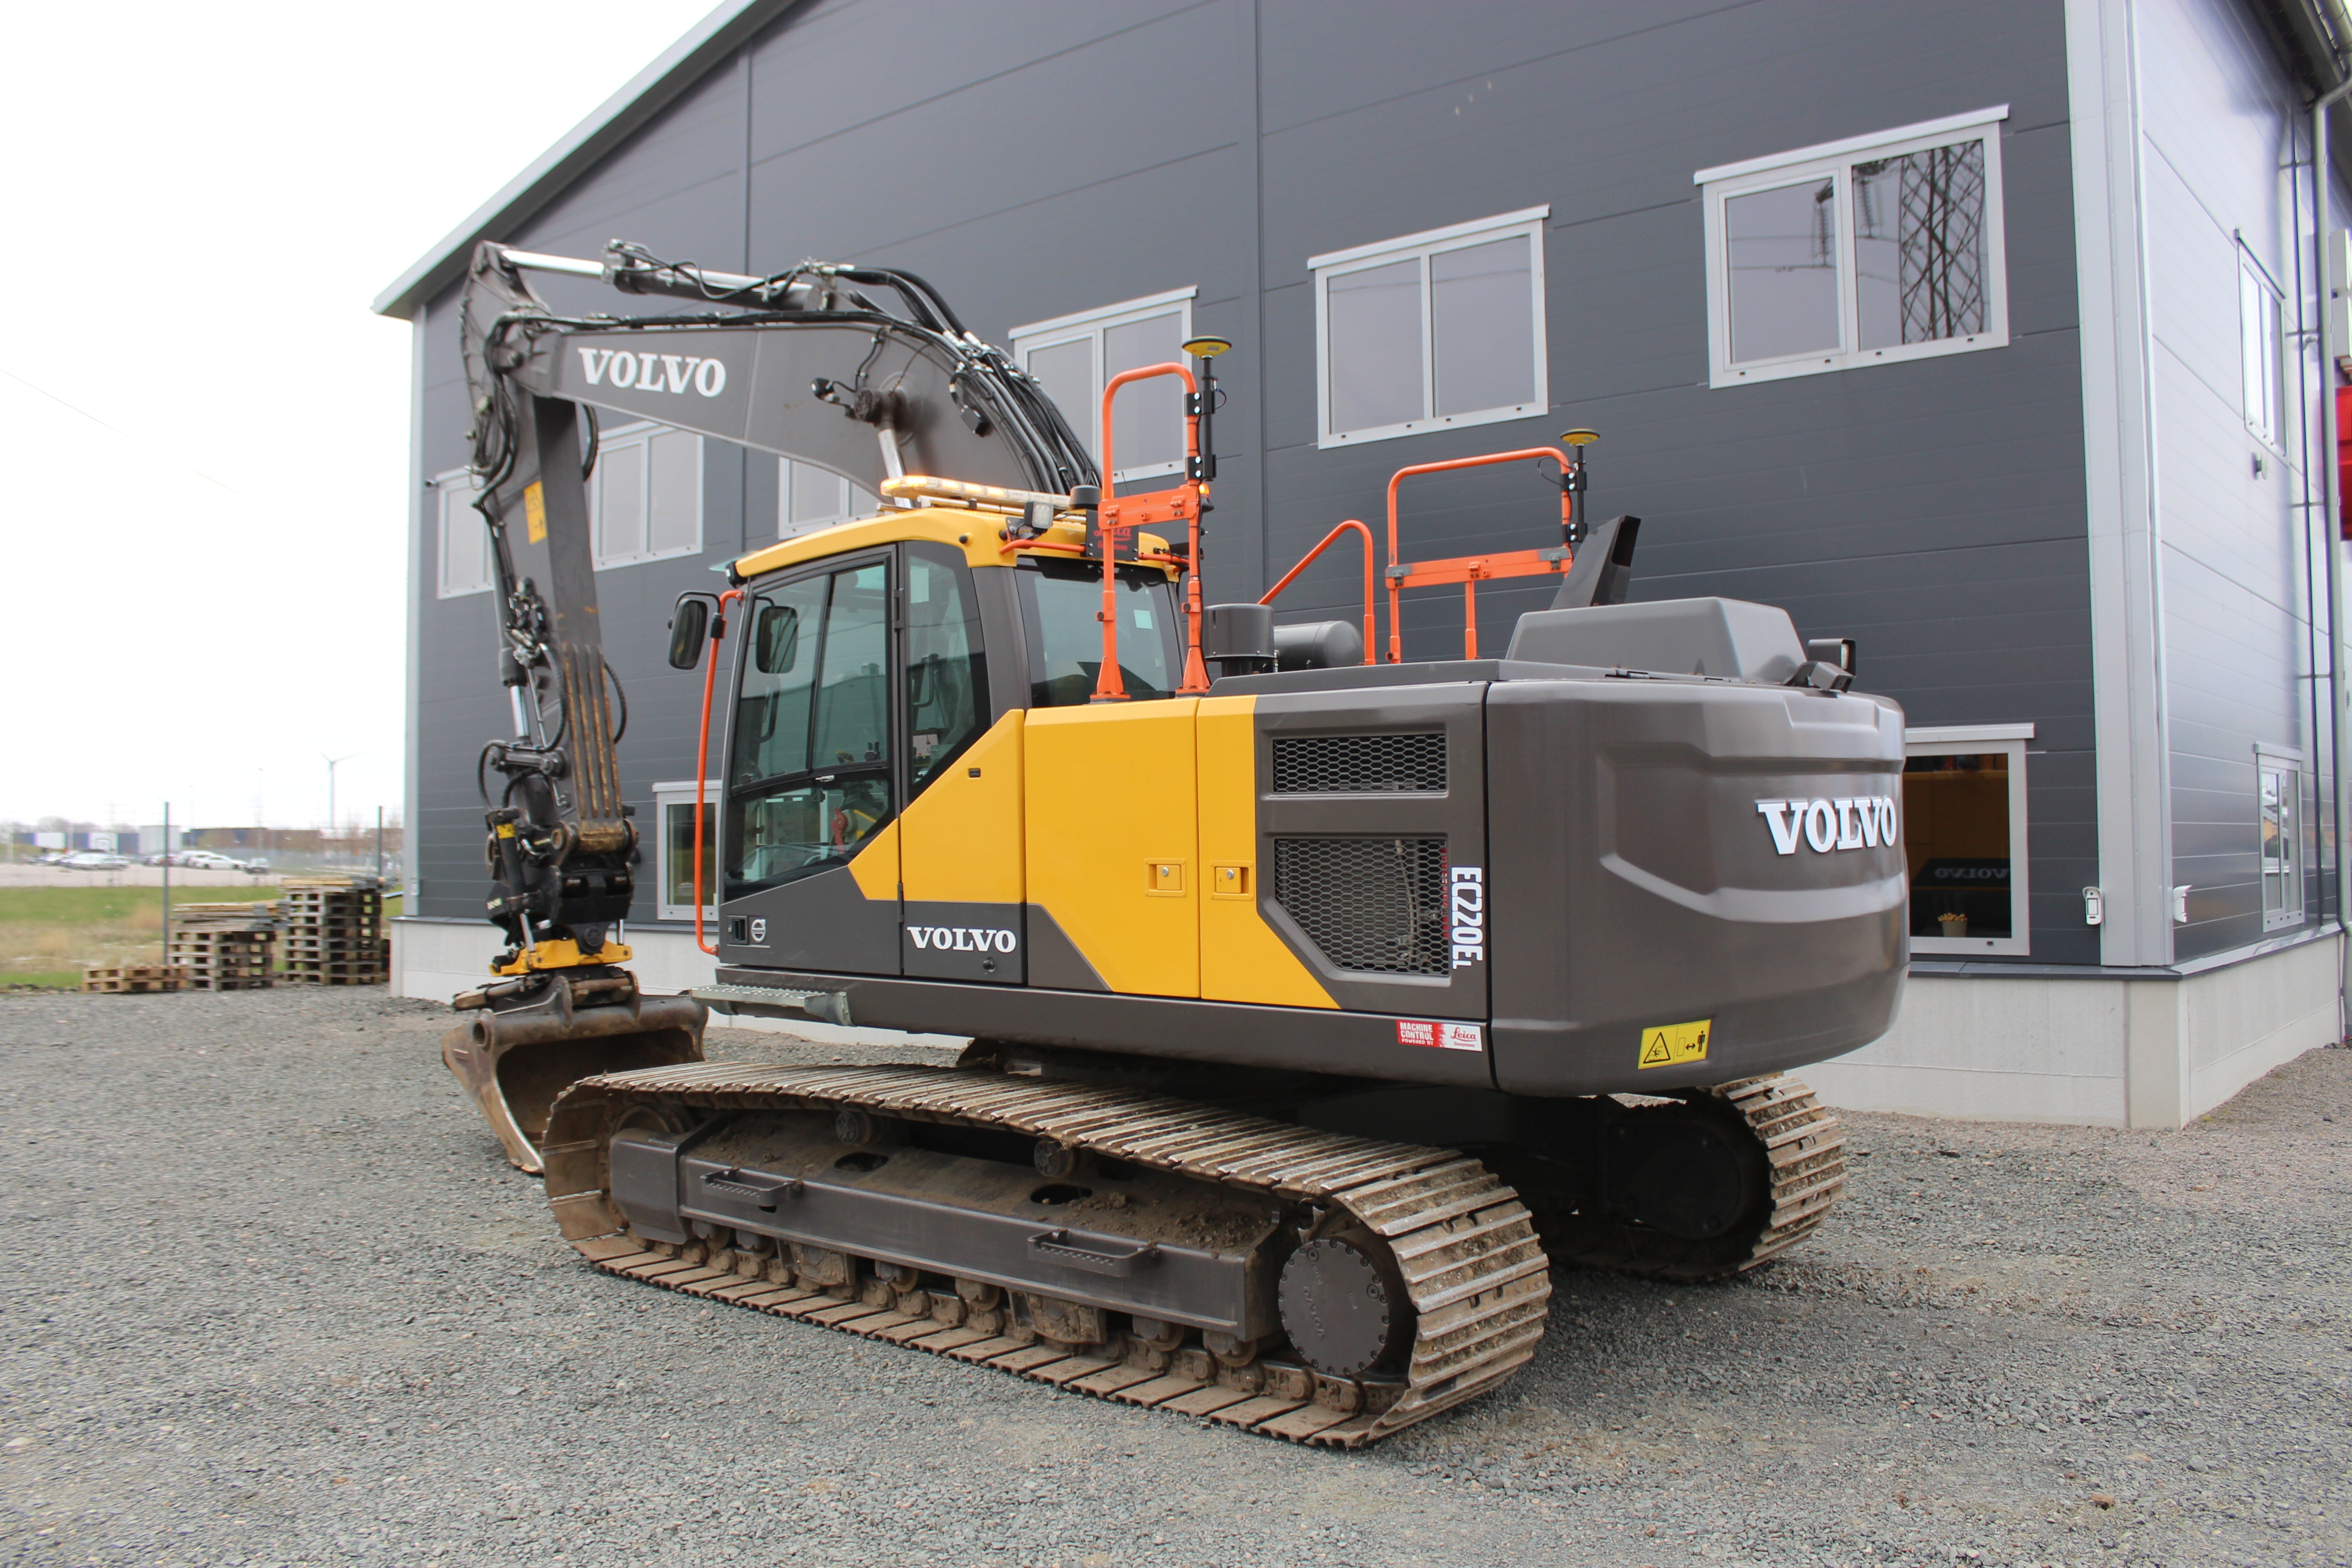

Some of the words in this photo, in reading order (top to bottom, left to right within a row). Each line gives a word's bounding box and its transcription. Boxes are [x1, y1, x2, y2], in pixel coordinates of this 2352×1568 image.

[577, 347, 727, 398] VOLVO
[1756, 796, 1898, 855] VOLVO
[906, 926, 1017, 953] VOLVO
[1400, 1022, 1433, 1033] MACHINE
[1400, 1030, 1434, 1041] CONTROL
[1450, 1027, 1478, 1042] Leica
